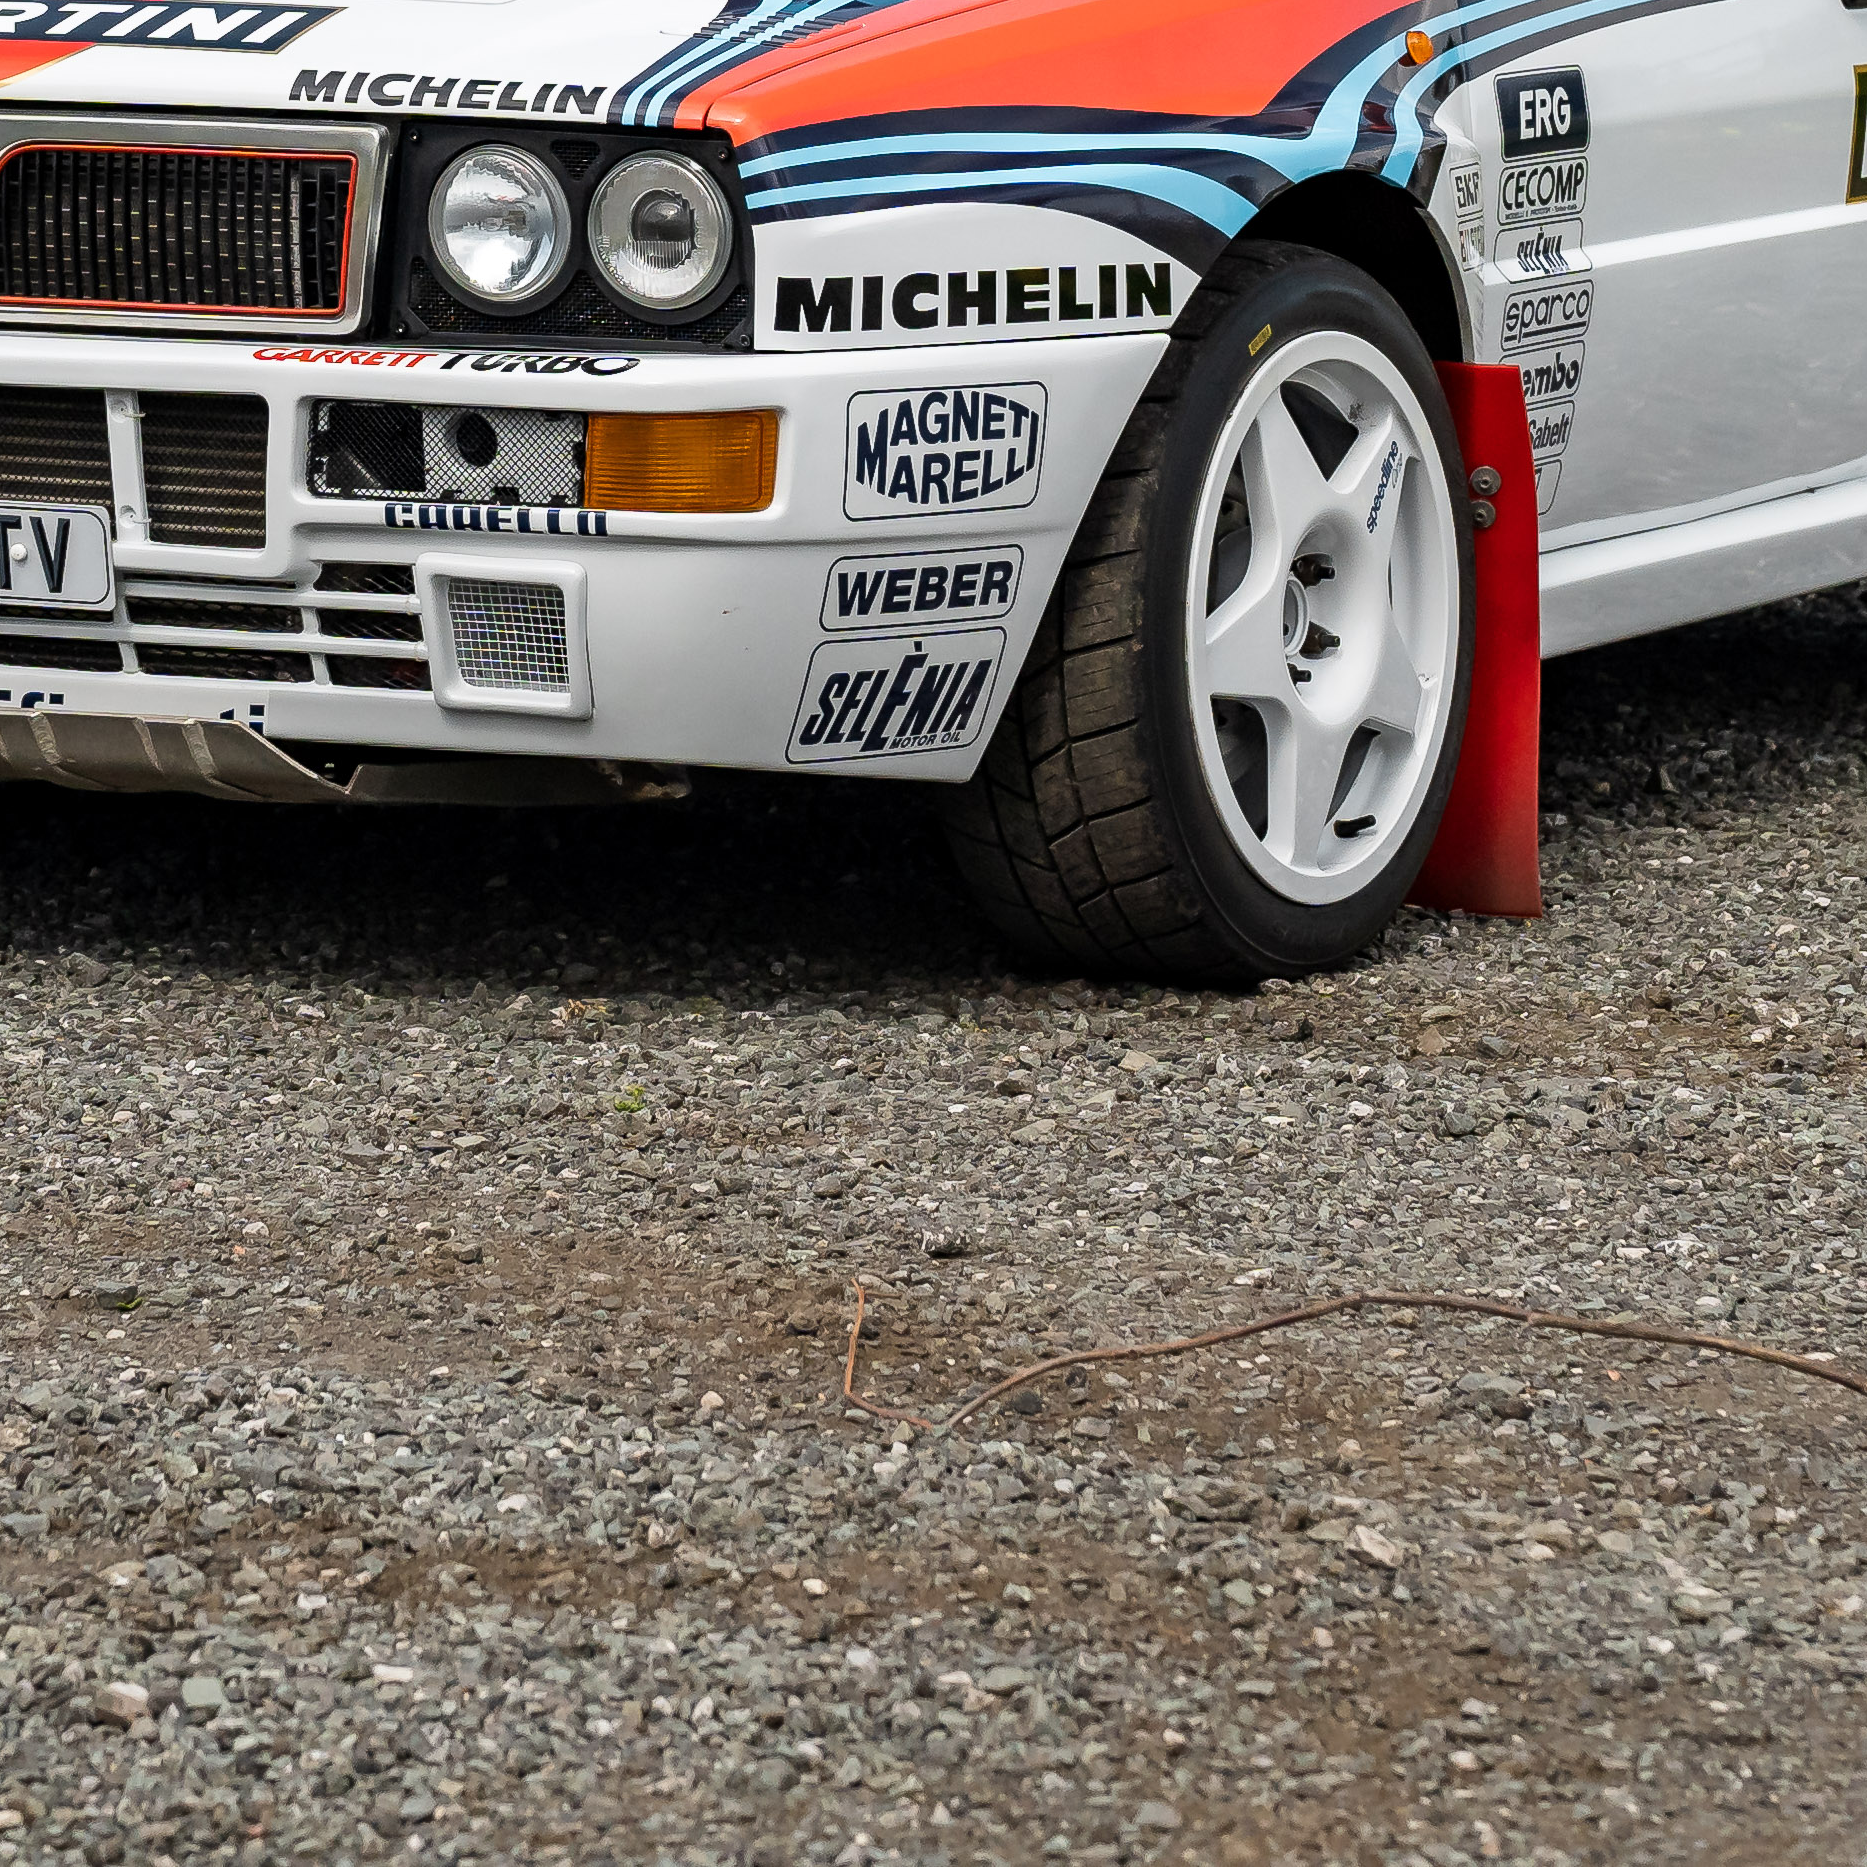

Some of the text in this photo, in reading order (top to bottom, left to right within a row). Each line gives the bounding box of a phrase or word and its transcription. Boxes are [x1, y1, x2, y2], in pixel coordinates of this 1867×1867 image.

[289, 69, 608, 115] MICHELIN
[1519, 86, 1572, 140] ERG
[1454, 171, 1479, 209] SKF
[1502, 162, 1584, 210] CECOMP
[774, 262, 1172, 332] MICHELIN
[1505, 288, 1590, 344] sparco
[252, 347, 641, 376] GARRETT TURBO
[1523, 351, 1580, 398] embo
[856, 390, 1040, 469] MAGNETI
[856, 429, 1040, 505] MARELLI
[1367, 440, 1399, 534] speedline
[837, 560, 1014, 618] WEBER
[889, 731, 962, 750] MOTOR OIL
